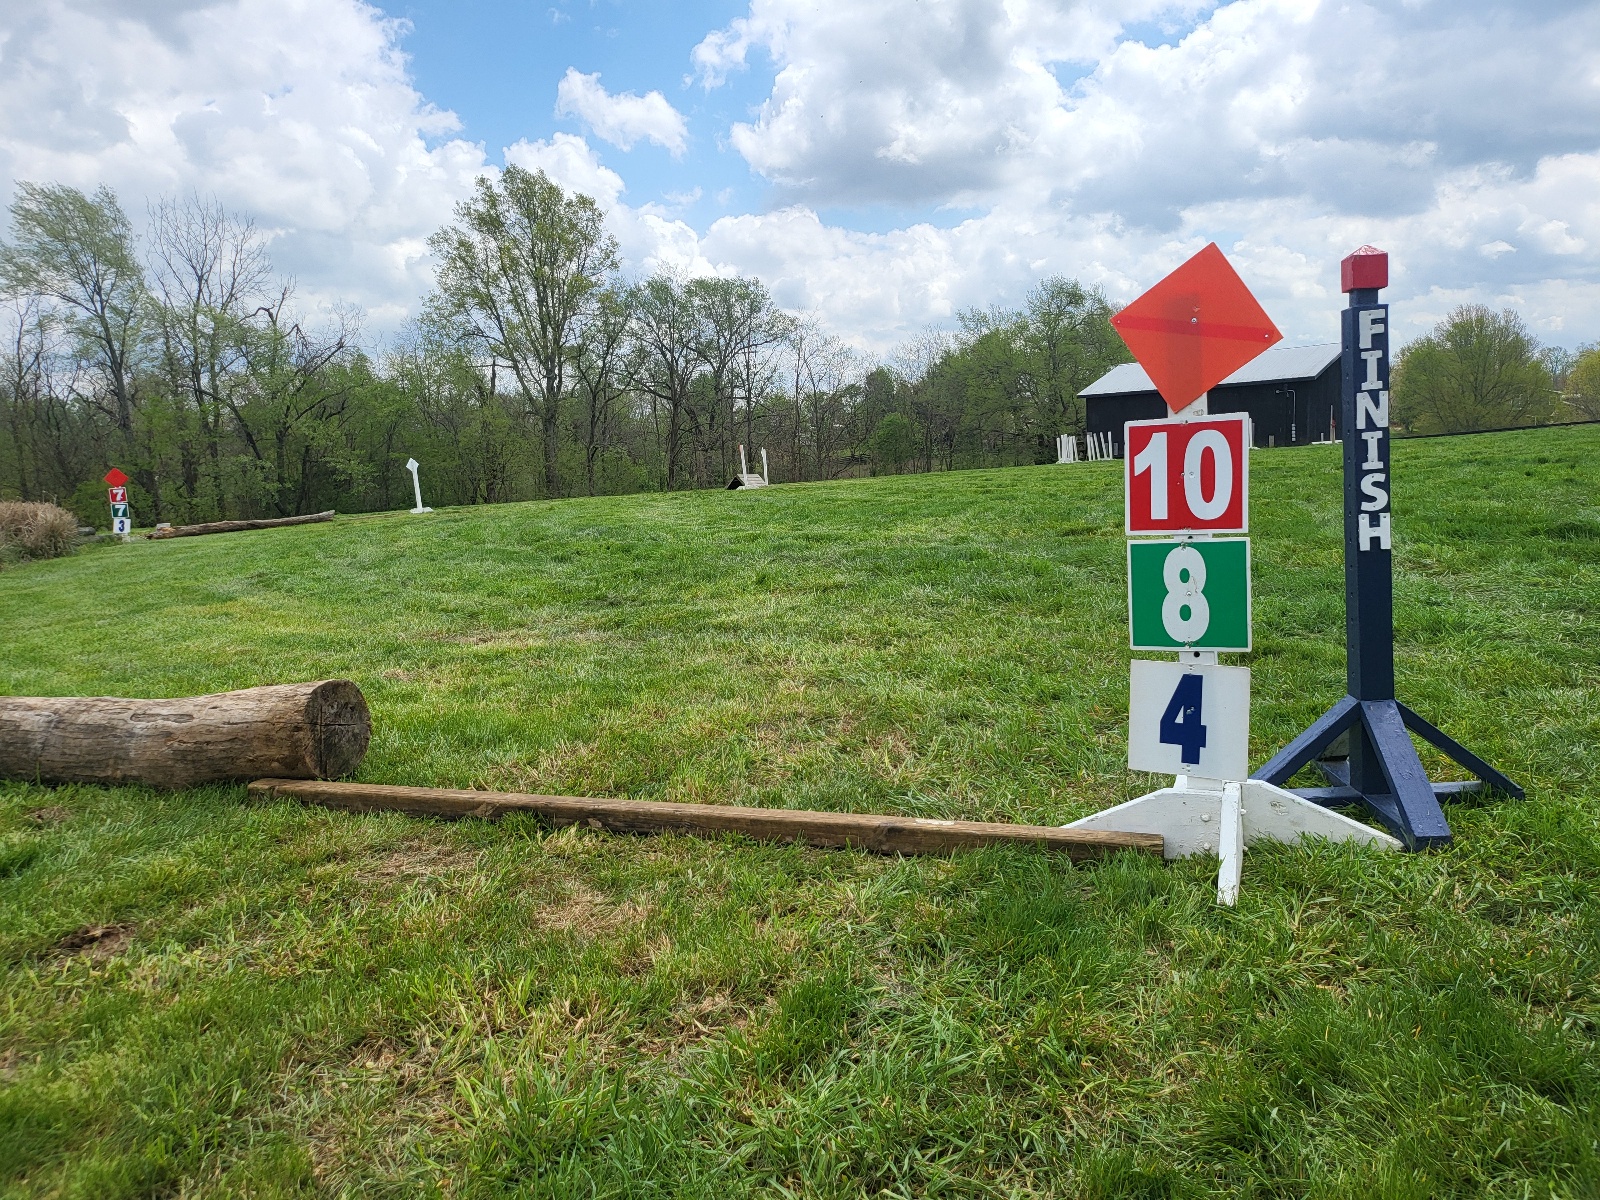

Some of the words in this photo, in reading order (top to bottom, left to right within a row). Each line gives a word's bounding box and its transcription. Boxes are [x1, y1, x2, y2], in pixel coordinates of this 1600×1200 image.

[1134, 429, 1233, 520] 10
[1356, 309, 1391, 551] FINISH
[112, 489, 124, 502] 7
[114, 505, 126, 516] 7
[118, 520, 125, 532] 3
[1161, 546, 1210, 643] 8
[1159, 673, 1207, 765] 4
